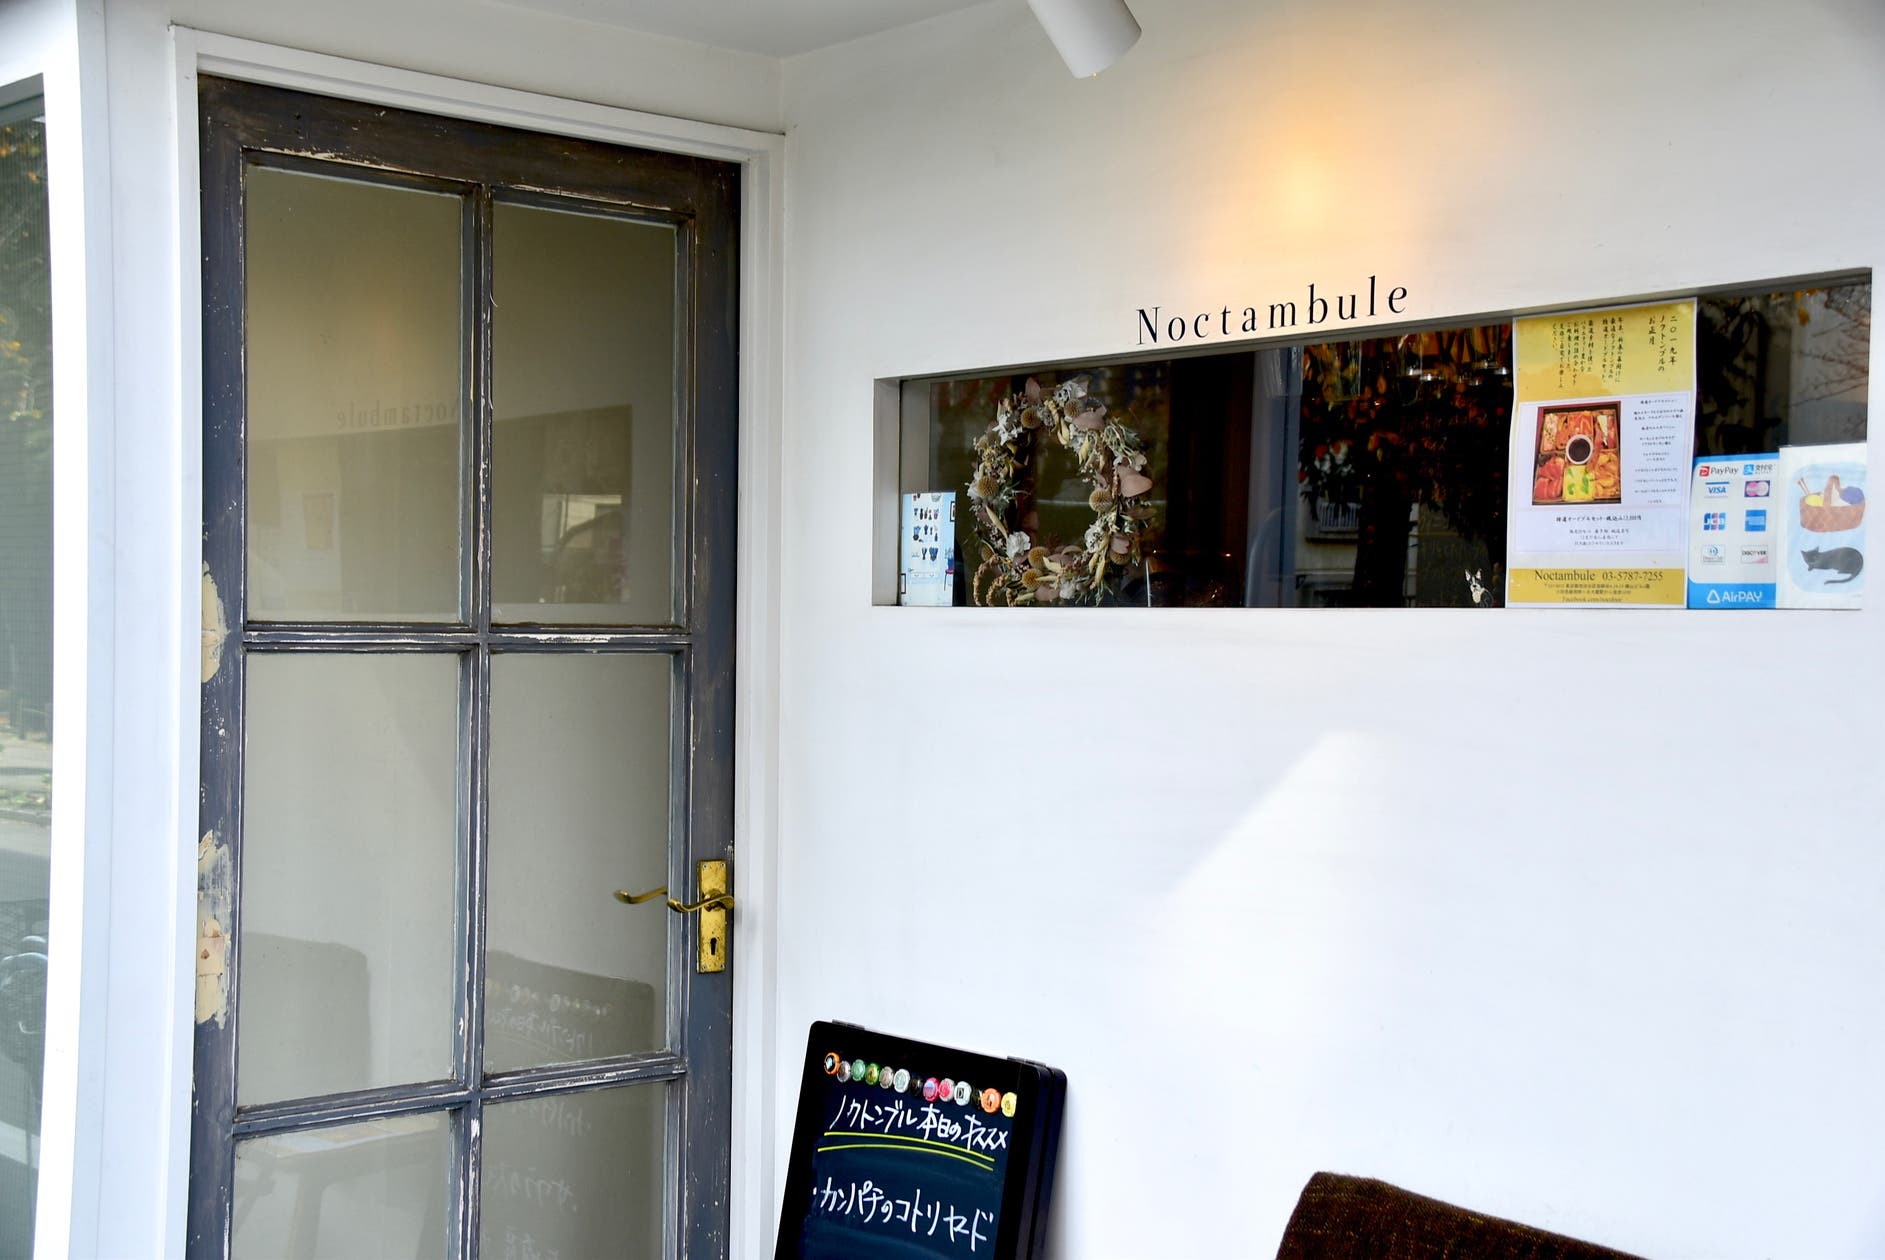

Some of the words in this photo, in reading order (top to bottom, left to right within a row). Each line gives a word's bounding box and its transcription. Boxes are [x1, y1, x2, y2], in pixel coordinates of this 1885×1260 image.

[1136, 275, 1408, 346] Noctambule
[1648, 316, 1657, 345] お正月
[1657, 314, 1667, 372] ノクトンブルの
[1711, 466, 1739, 475] PayPay
[1708, 486, 1727, 494] VISA
[1535, 570, 1596, 581] Noctambule
[1602, 571, 1664, 581] 03-5787-7255
[1722, 590, 1763, 604] AirPAY
